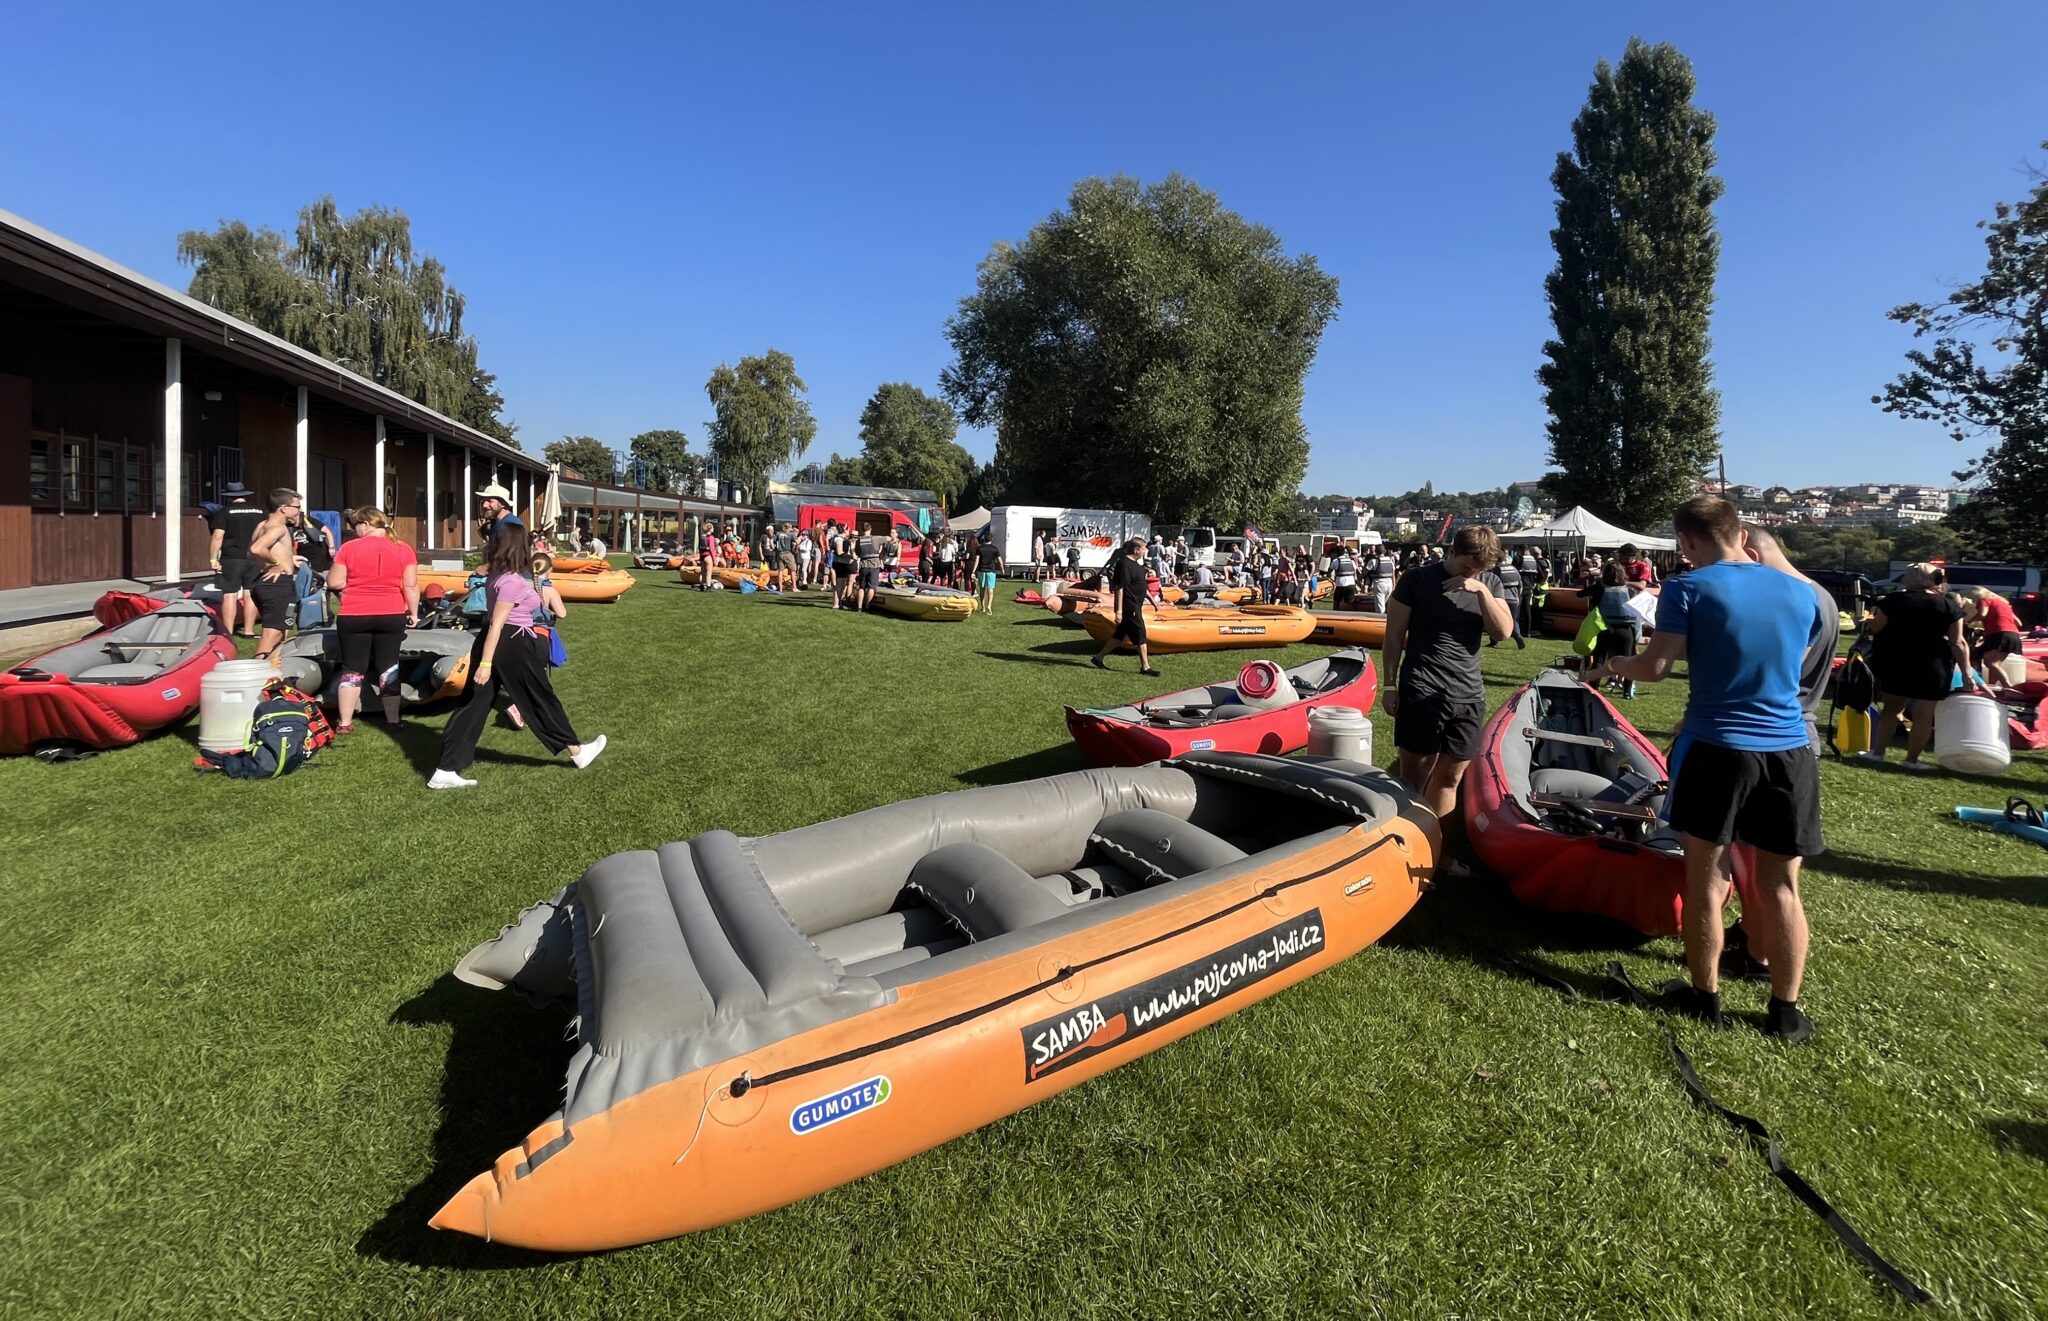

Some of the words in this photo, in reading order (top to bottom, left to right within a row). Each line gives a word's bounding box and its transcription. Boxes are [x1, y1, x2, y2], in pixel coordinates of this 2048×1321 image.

[1060, 524, 1102, 538] SAMBA
[1344, 875, 1373, 895] Colorado
[1031, 1003, 1107, 1065] SAMBA
[1133, 925, 1323, 1027] www.pujcovna-lodi.cz
[798, 1079, 885, 1127] GUMOTEX
